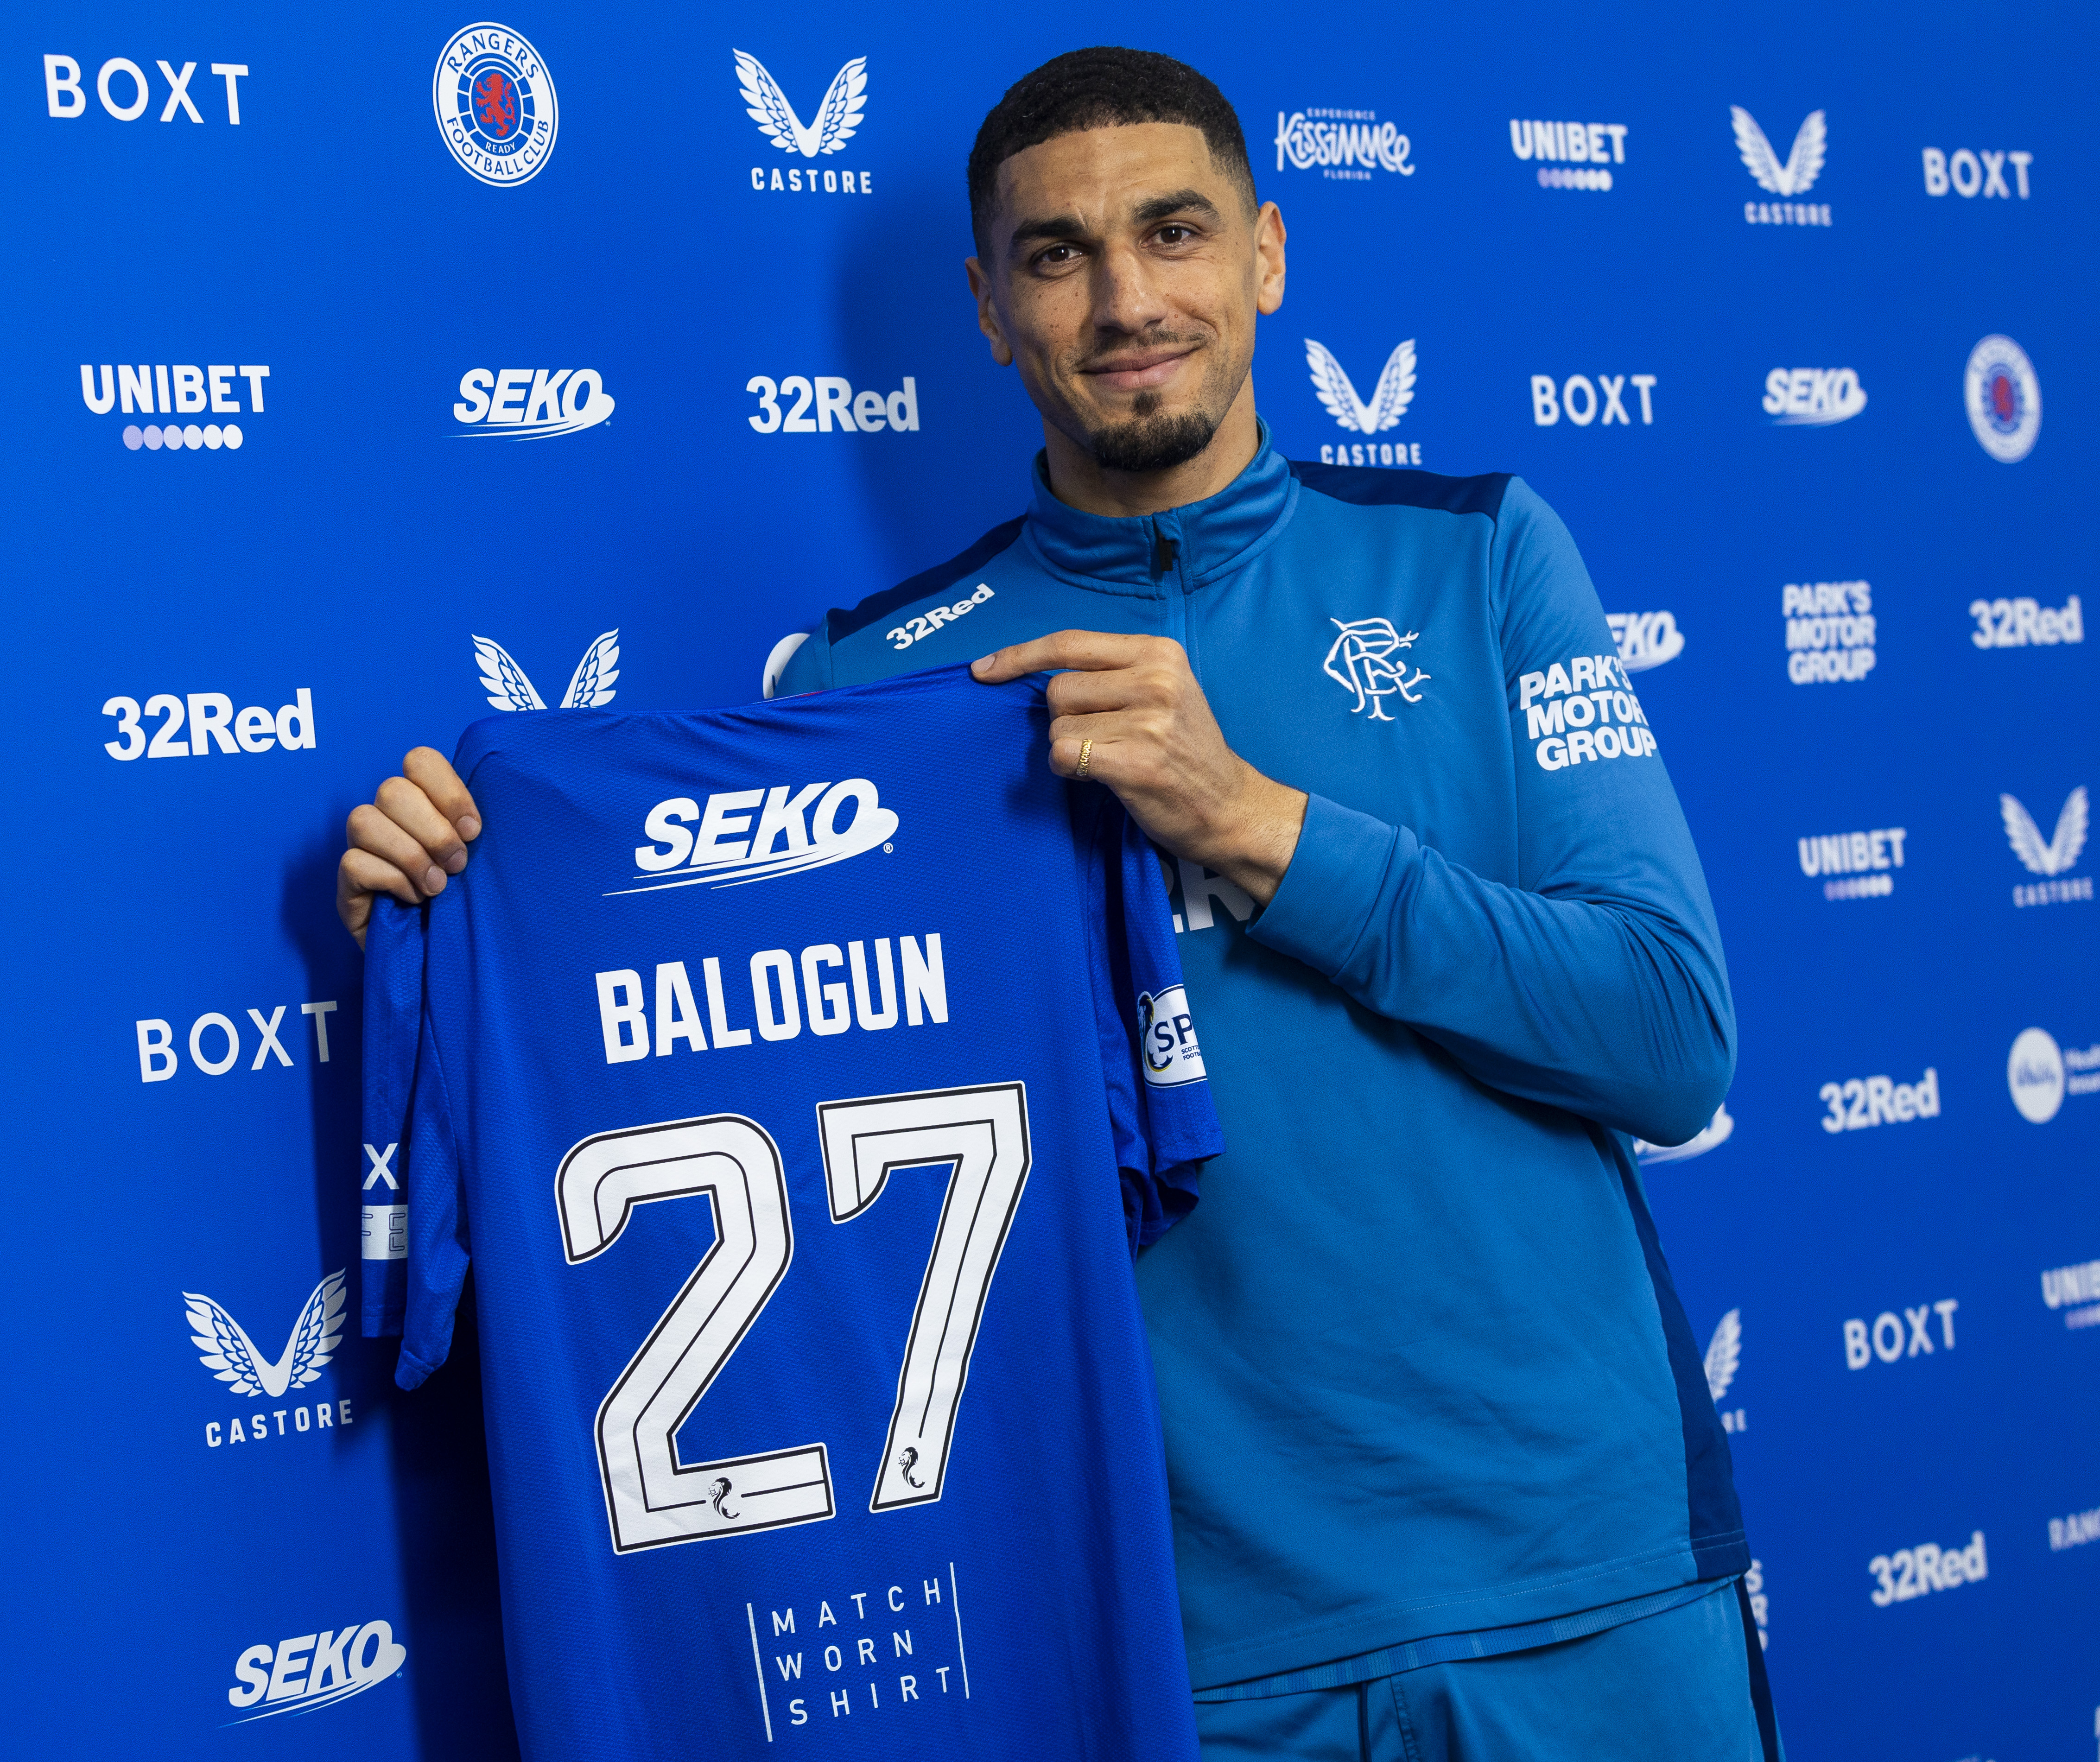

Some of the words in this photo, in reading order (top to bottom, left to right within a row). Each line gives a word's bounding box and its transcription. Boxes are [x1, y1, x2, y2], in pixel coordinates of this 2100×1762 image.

[447, 33, 539, 78] RANGERS
[44, 54, 248, 125] BOXT
[446, 117, 523, 176] FOOTBALL
[523, 120, 549, 165] CLUB
[485, 141, 516, 154] READY
[1510, 120, 1627, 163] UNIBET
[751, 168, 872, 193] CASTORE
[1923, 148, 2032, 198] BOXT
[80, 365, 270, 414] UNIBET
[453, 368, 615, 423] SEKO
[746, 375, 920, 434] 32Red
[1531, 375, 1656, 425] BOXT
[1762, 368, 1868, 415] SEKO
[1321, 444, 1421, 466] CASTORE
[886, 583, 996, 650] 32Red
[1783, 581, 1872, 617] PARK'S
[1970, 596, 2083, 648] 32Red
[1785, 615, 1875, 651] MOTOR
[1788, 649, 1875, 685] GROUP
[102, 688, 316, 761] 32Red
[1527, 690, 1649, 740] MOTOR
[1536, 726, 1657, 771] GROUP
[635, 778, 899, 871] SEKO
[1799, 827, 1906, 877] UNIBET
[596, 933, 948, 1064] BALOGUN
[136, 1001, 336, 1083] BOXT
[1820, 1068, 1940, 1133] 32Red
[555, 1080, 1032, 1555] 27
[1844, 1299, 1957, 1369] BOXT
[206, 1400, 352, 1447] CASTORE
[1870, 1531, 1987, 1606] 32Red
[772, 1578, 941, 1636] MATCH
[228, 1620, 406, 1707] SEKO
[776, 1629, 913, 1681] WORN
[789, 1667, 950, 1725] SHIRT
